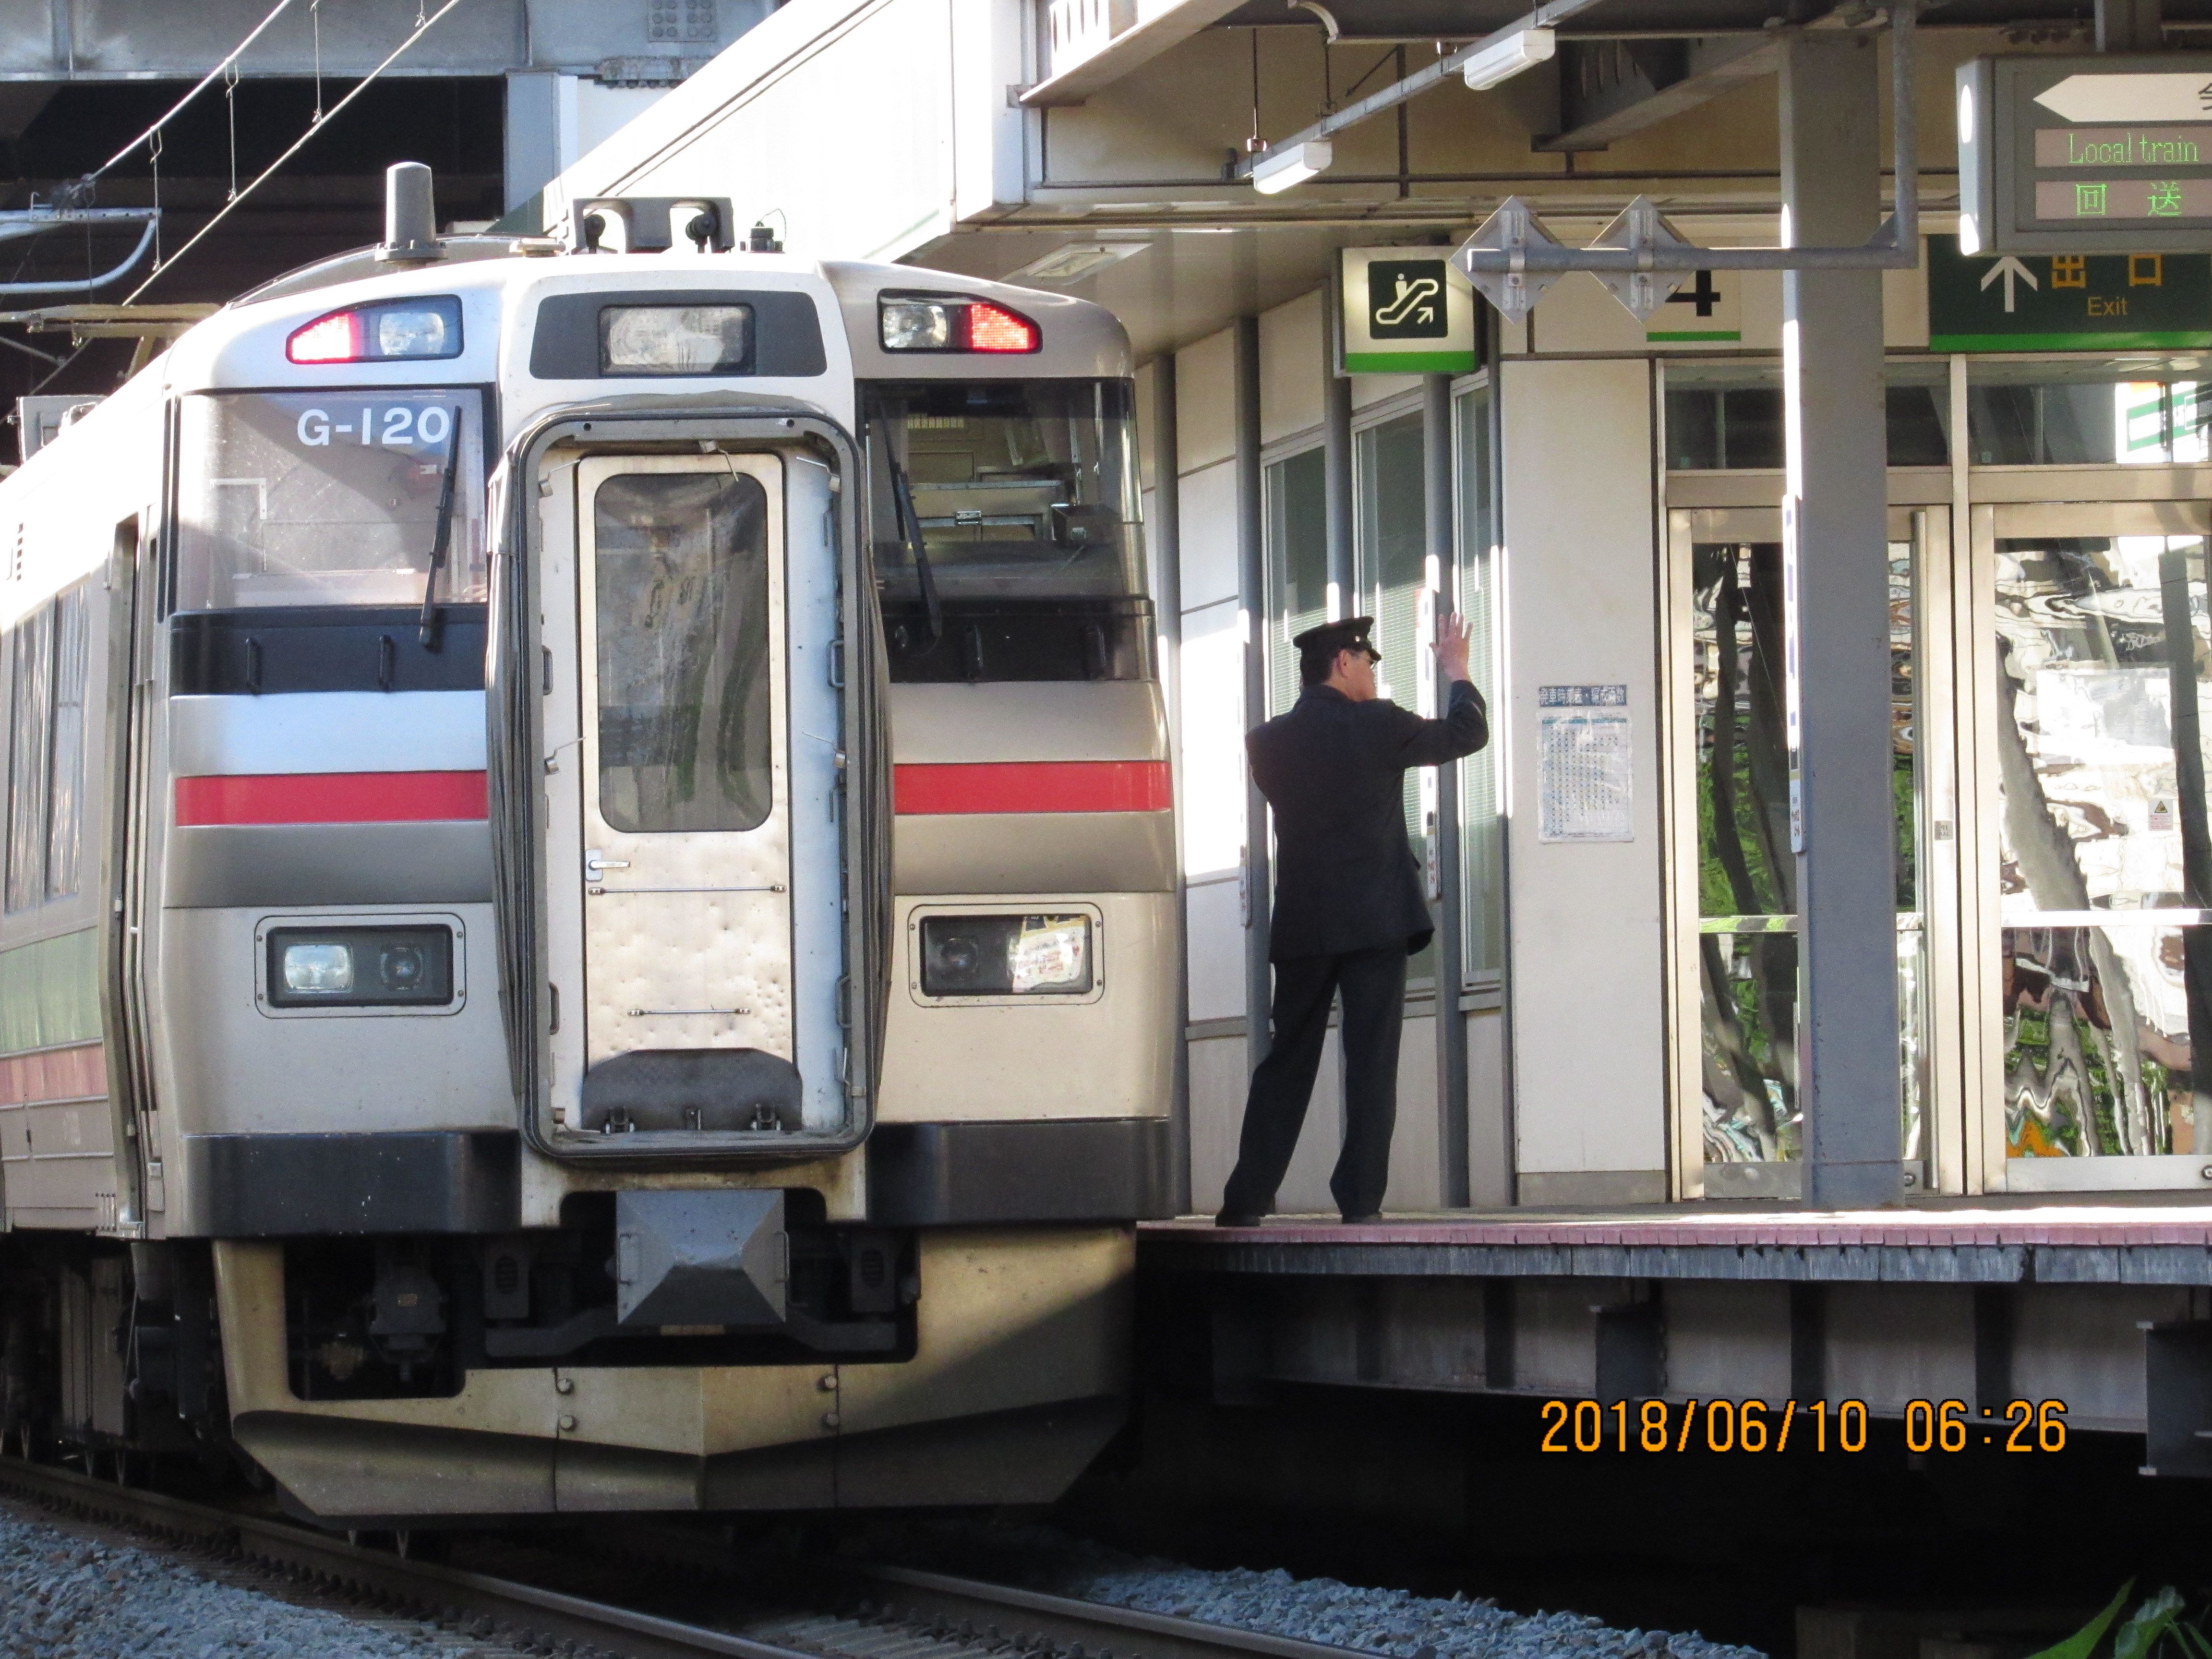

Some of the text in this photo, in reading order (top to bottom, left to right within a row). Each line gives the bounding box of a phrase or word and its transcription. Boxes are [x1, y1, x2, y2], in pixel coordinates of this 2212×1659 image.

[2068, 132, 2199, 164] Local train
[2087, 296, 2128, 317] Exit
[297, 407, 450, 446] G-120
